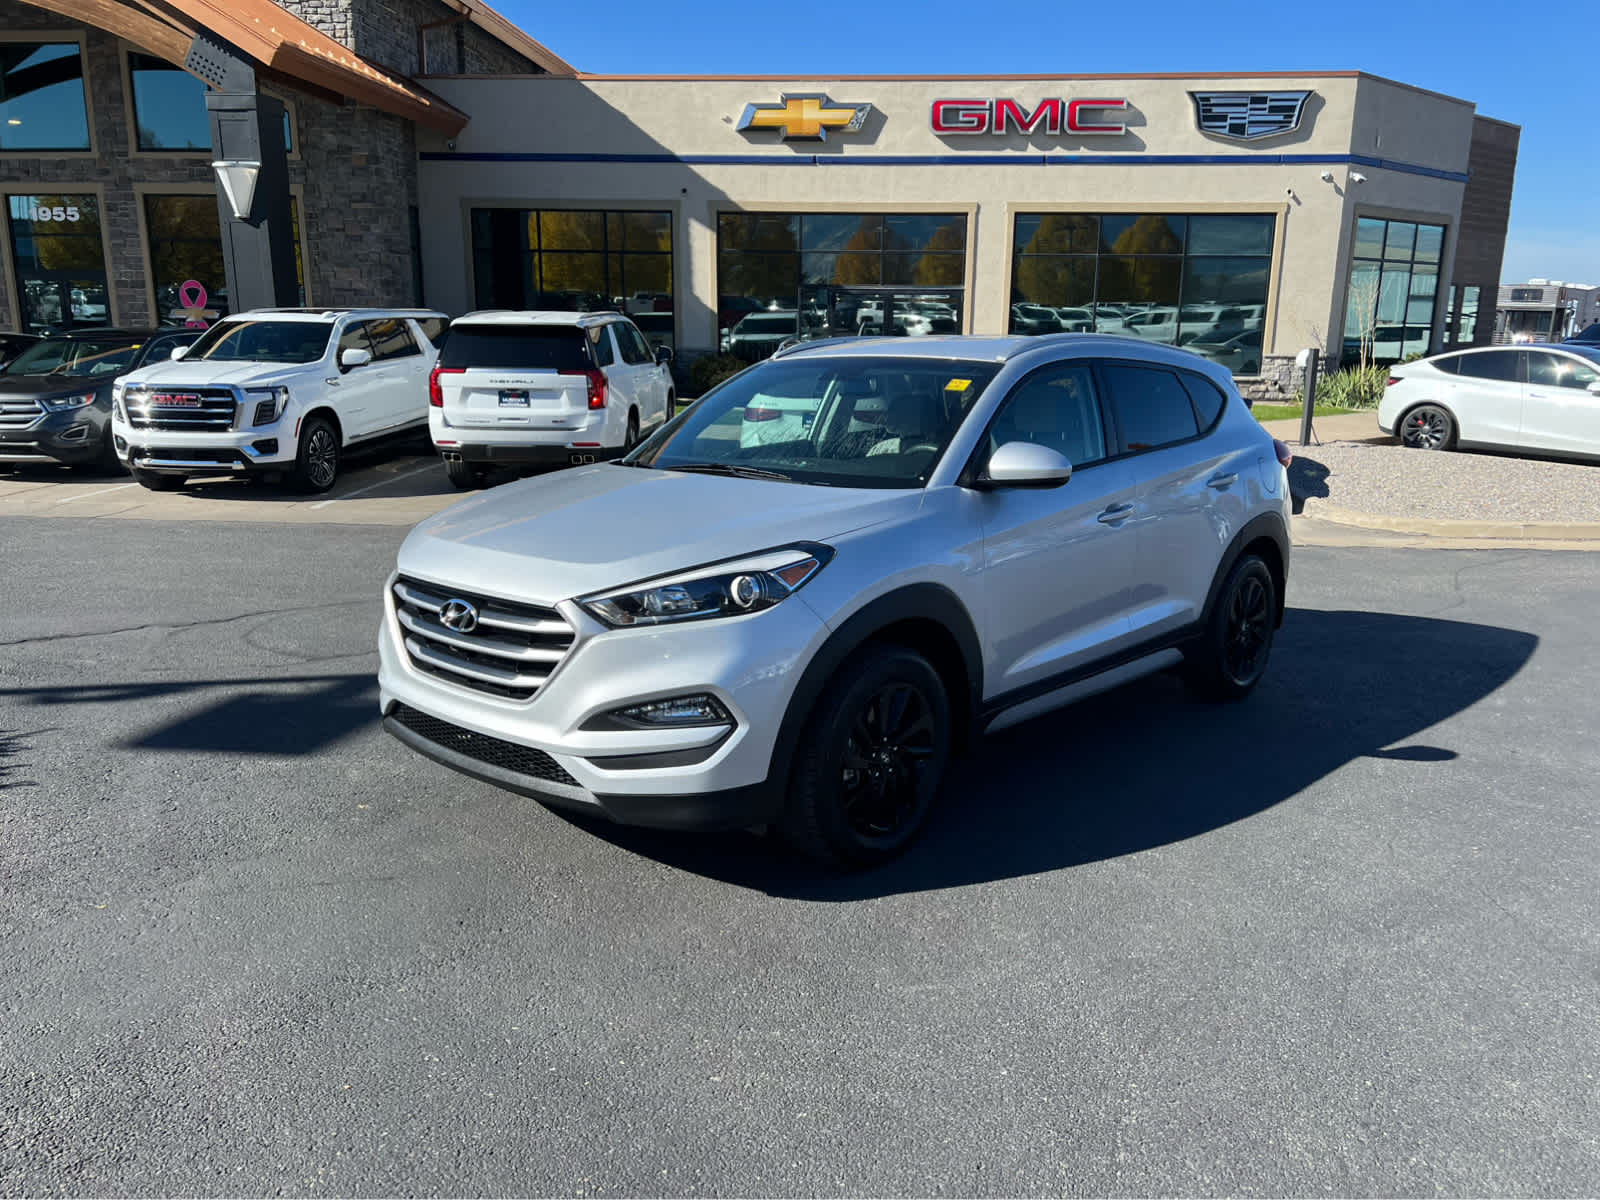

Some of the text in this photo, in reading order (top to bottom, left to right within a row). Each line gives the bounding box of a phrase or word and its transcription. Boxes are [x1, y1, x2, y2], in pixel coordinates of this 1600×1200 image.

[929, 97, 1127, 136] GMC
[29, 206, 80, 221] 1955
[152, 394, 198, 405] GMC
